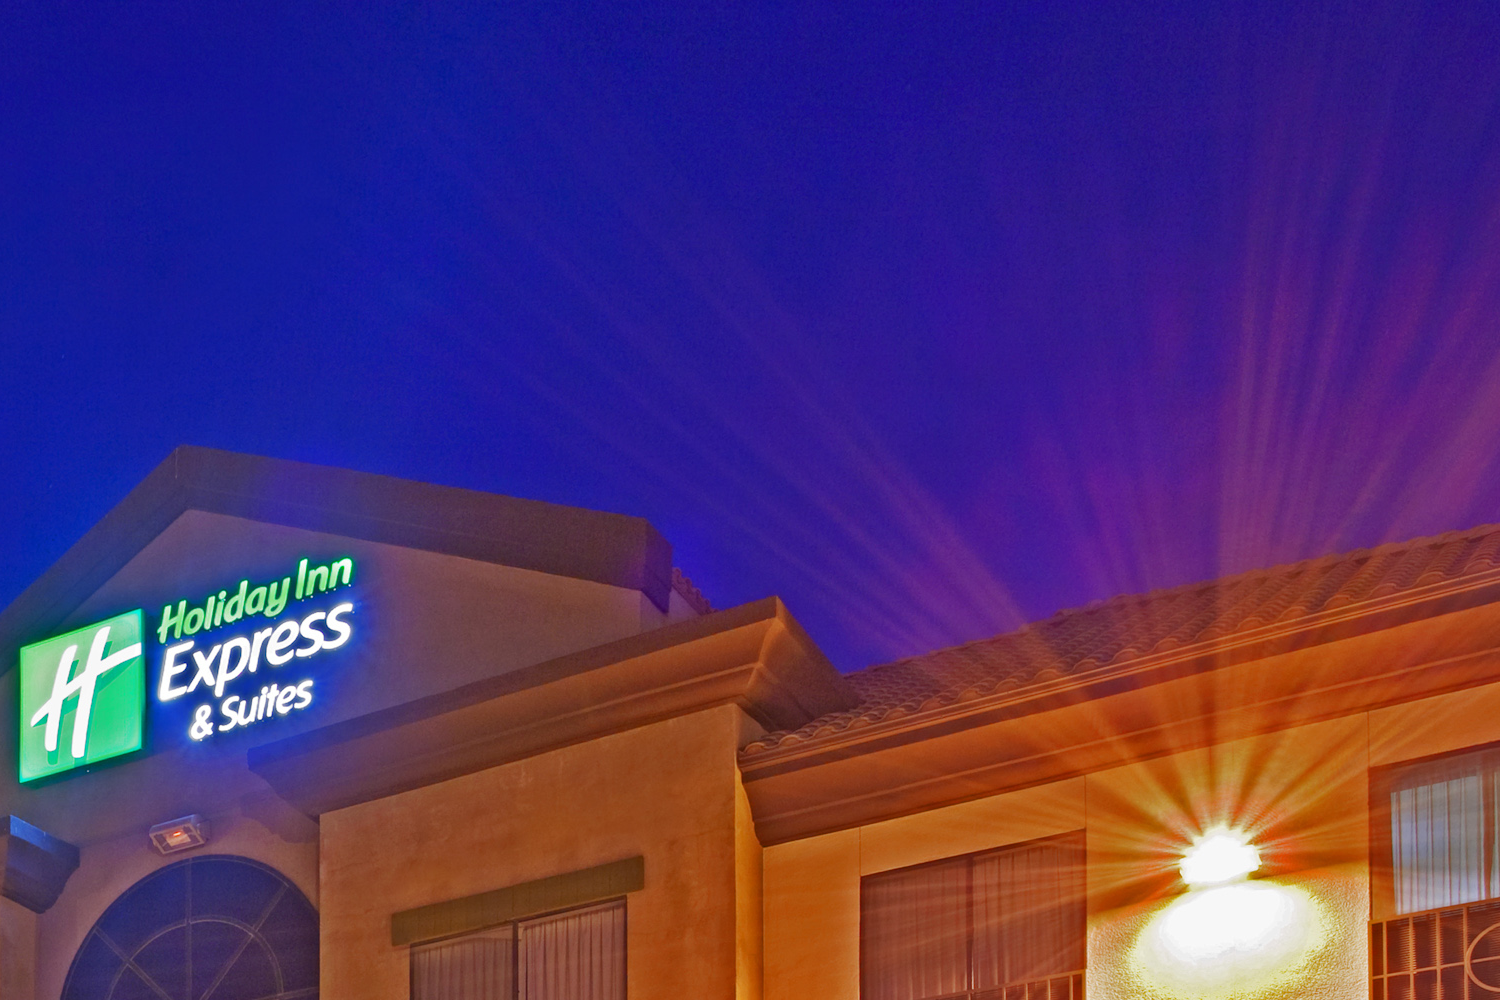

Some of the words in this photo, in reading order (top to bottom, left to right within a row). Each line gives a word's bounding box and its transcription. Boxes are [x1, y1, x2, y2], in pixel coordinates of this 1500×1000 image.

[157, 577, 290, 643] Holiday
[295, 557, 353, 600] Inn
[157, 602, 354, 701] Express
[188, 704, 214, 741] &
[218, 679, 314, 732] Suites
